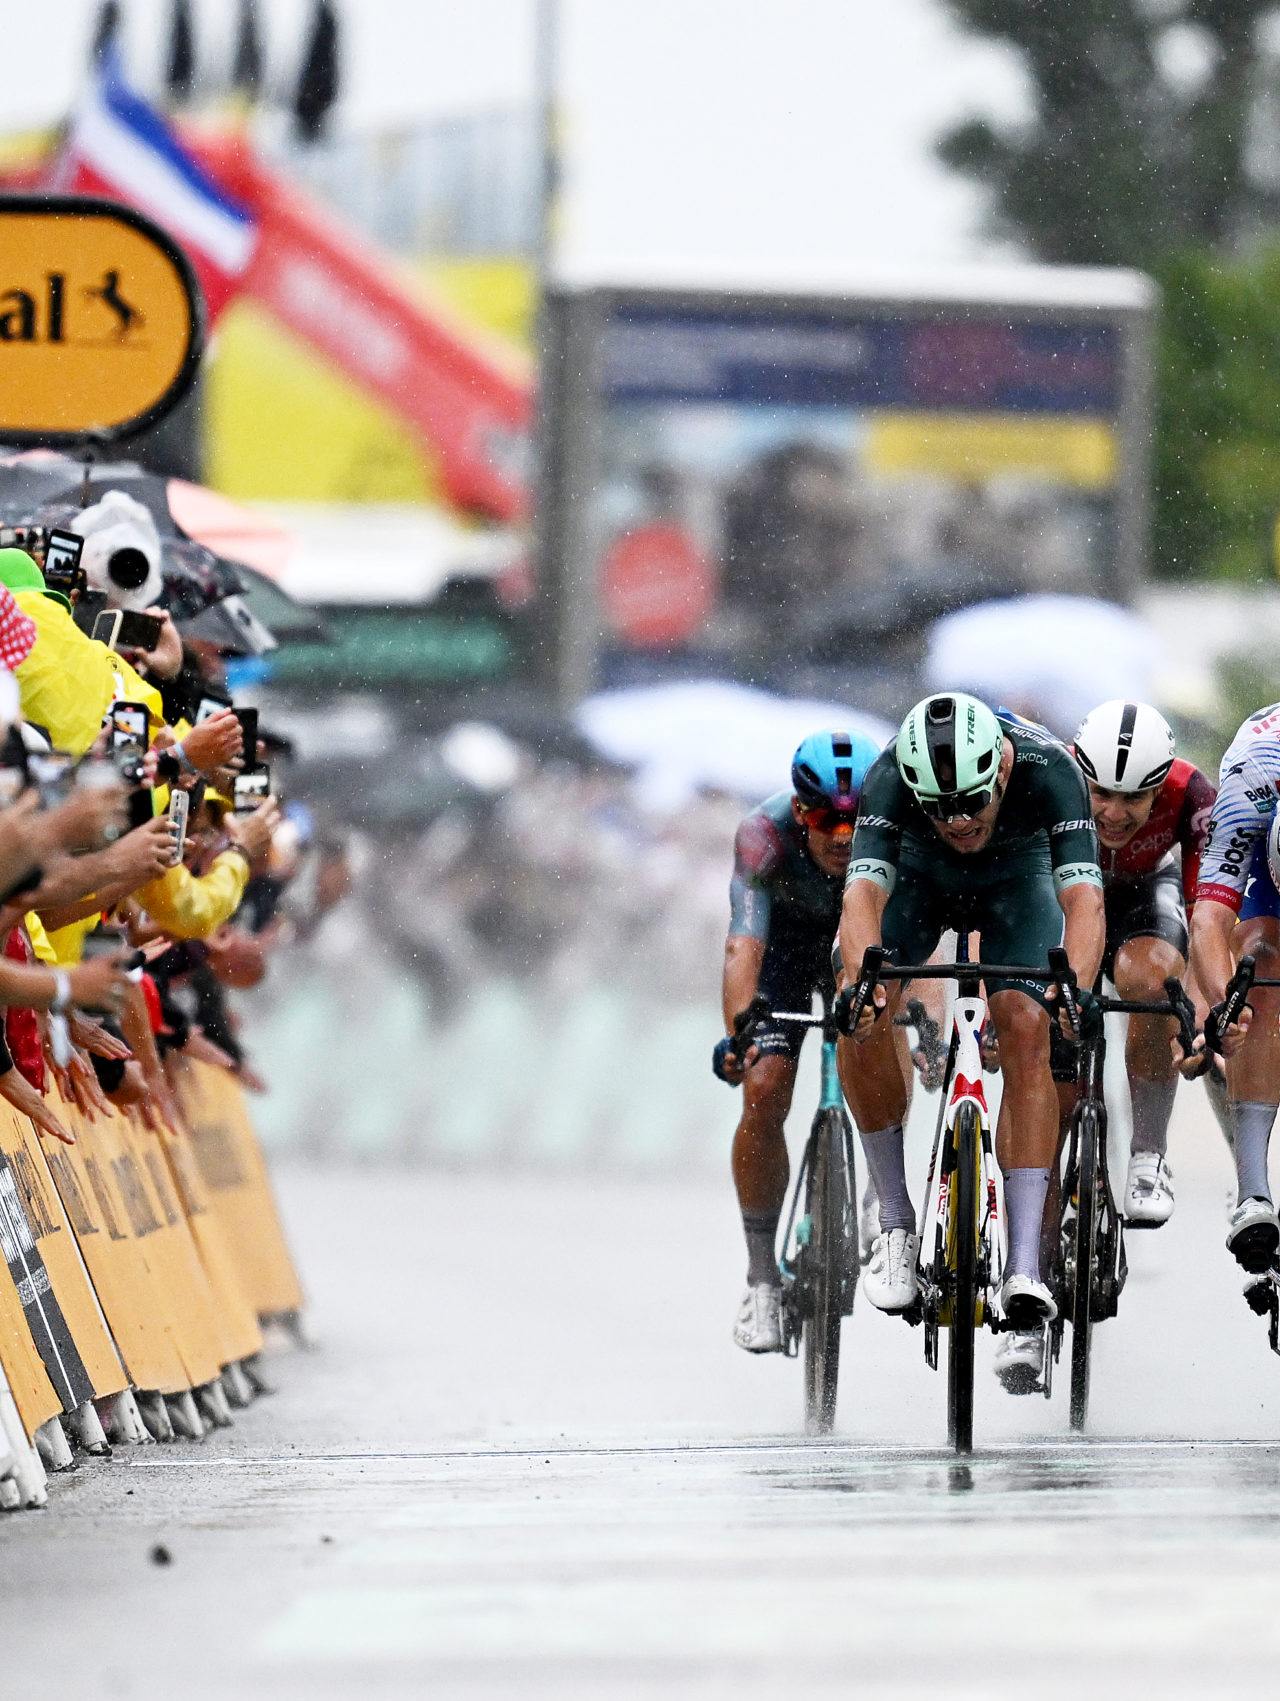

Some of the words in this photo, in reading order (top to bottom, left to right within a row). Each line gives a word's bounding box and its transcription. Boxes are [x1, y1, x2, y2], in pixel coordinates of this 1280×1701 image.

[966, 702, 976, 747] TREK
[1244, 785, 1276, 802] BRA
[1219, 826, 1256, 878] BOSS
[1219, 991, 1240, 1029] SRAM
